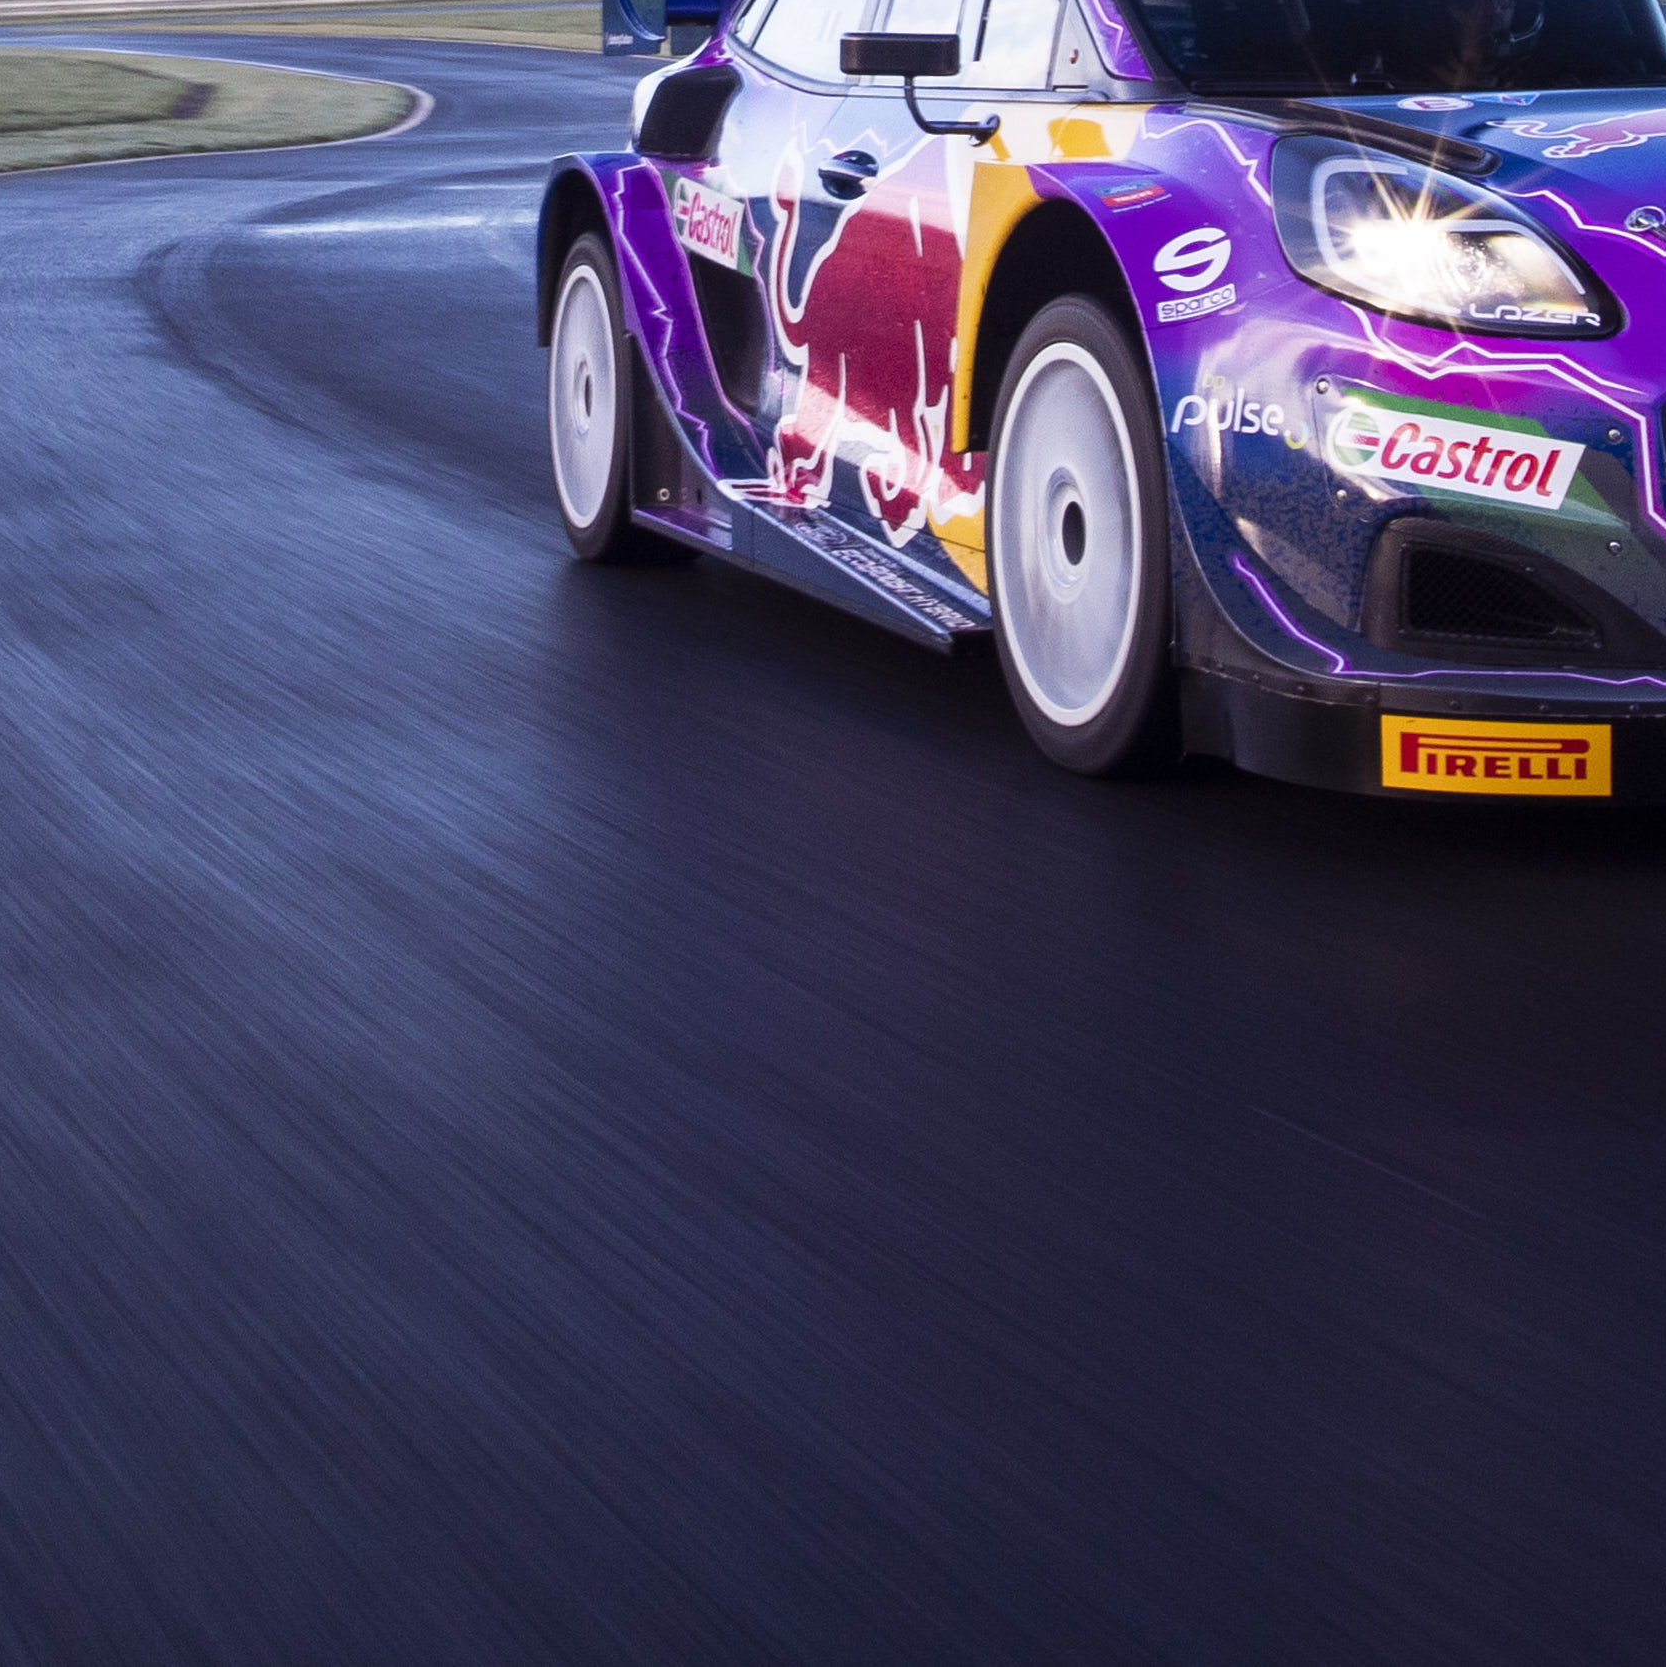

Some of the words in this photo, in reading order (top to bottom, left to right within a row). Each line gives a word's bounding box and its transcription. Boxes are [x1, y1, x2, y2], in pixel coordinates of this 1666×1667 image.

[688, 192, 738, 258] Castrol
[1161, 287, 1234, 319] sparco
[1469, 302, 1601, 327] LAZER
[1171, 387, 1284, 436] pulse
[1380, 422, 1562, 497] Castrol
[1400, 731, 1590, 780] PIRELLI
